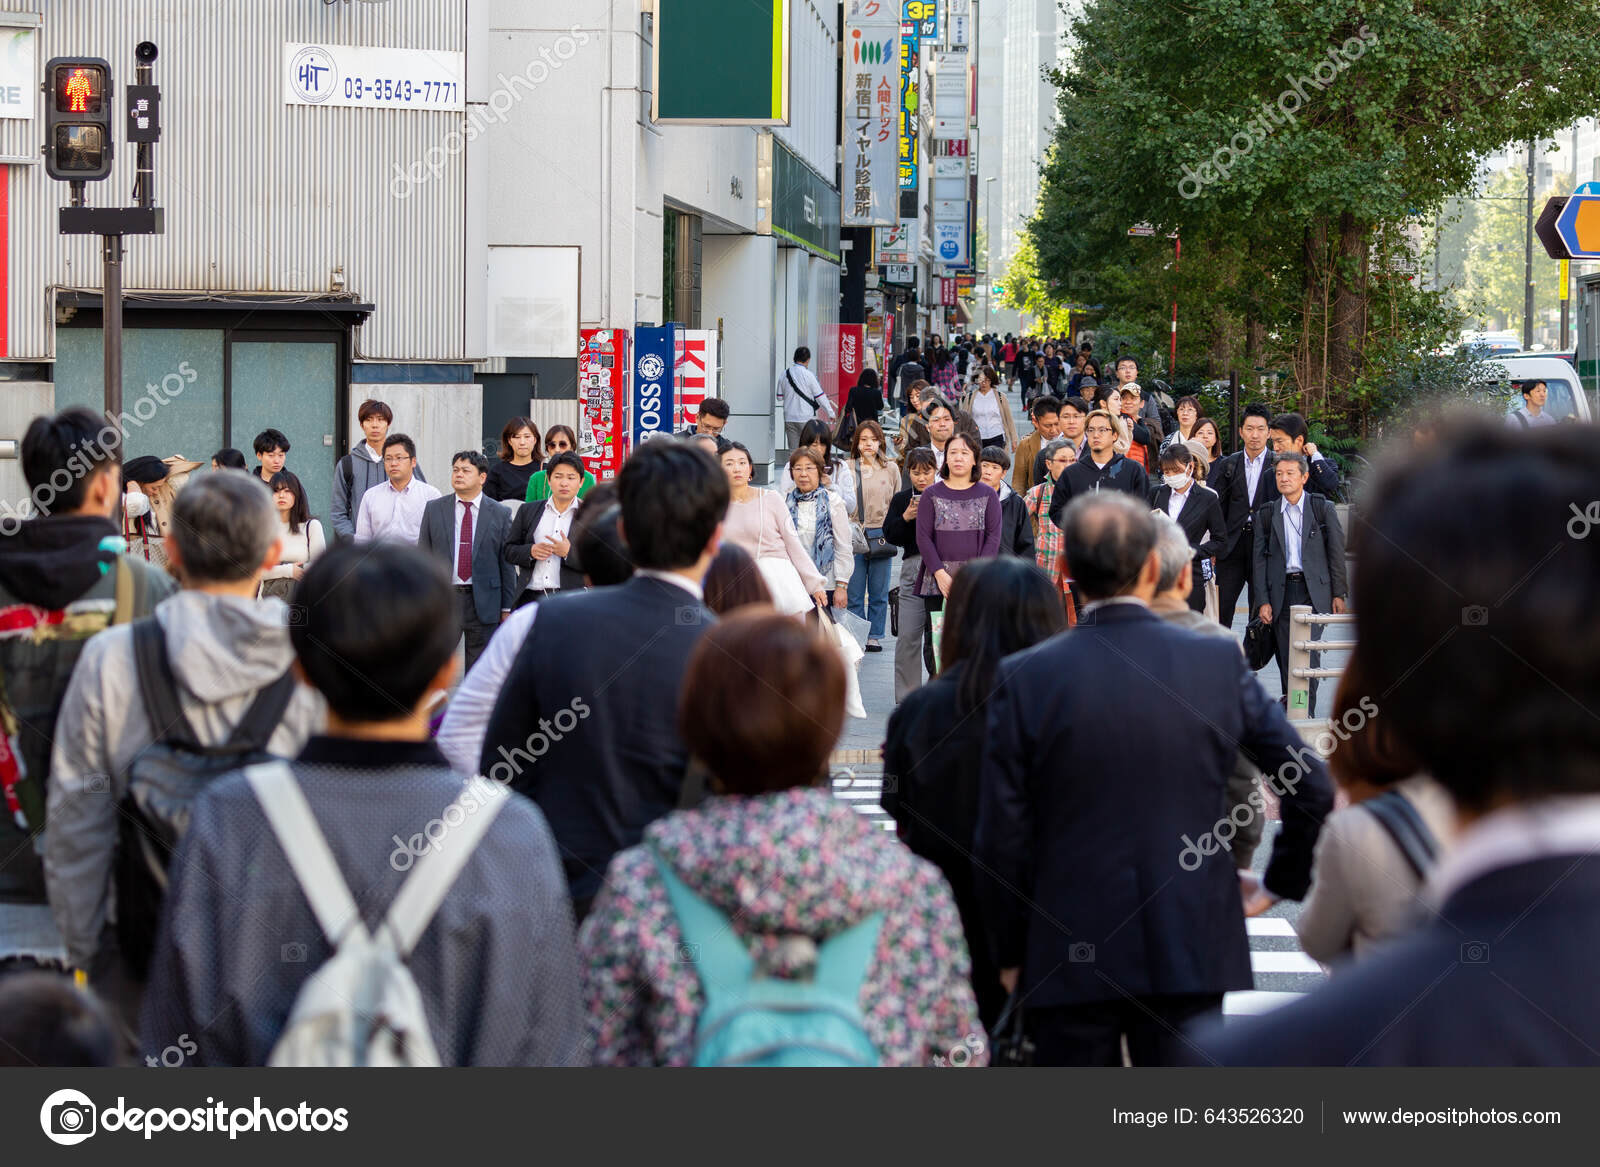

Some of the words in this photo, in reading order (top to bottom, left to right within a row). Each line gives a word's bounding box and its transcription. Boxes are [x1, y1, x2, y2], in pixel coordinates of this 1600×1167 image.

[907, 1, 936, 20] 3F
[344, 77, 457, 103] 03-3543-7771
[136, 99, 149, 129] 音響
[877, 75, 891, 142] 人間ドック
[855, 73, 872, 217] 新宿ロイヤル診療所
[841, 332, 856, 374] Coca-Cola
[640, 383, 661, 444] BOSS
[1295, 692, 1304, 704] 1
